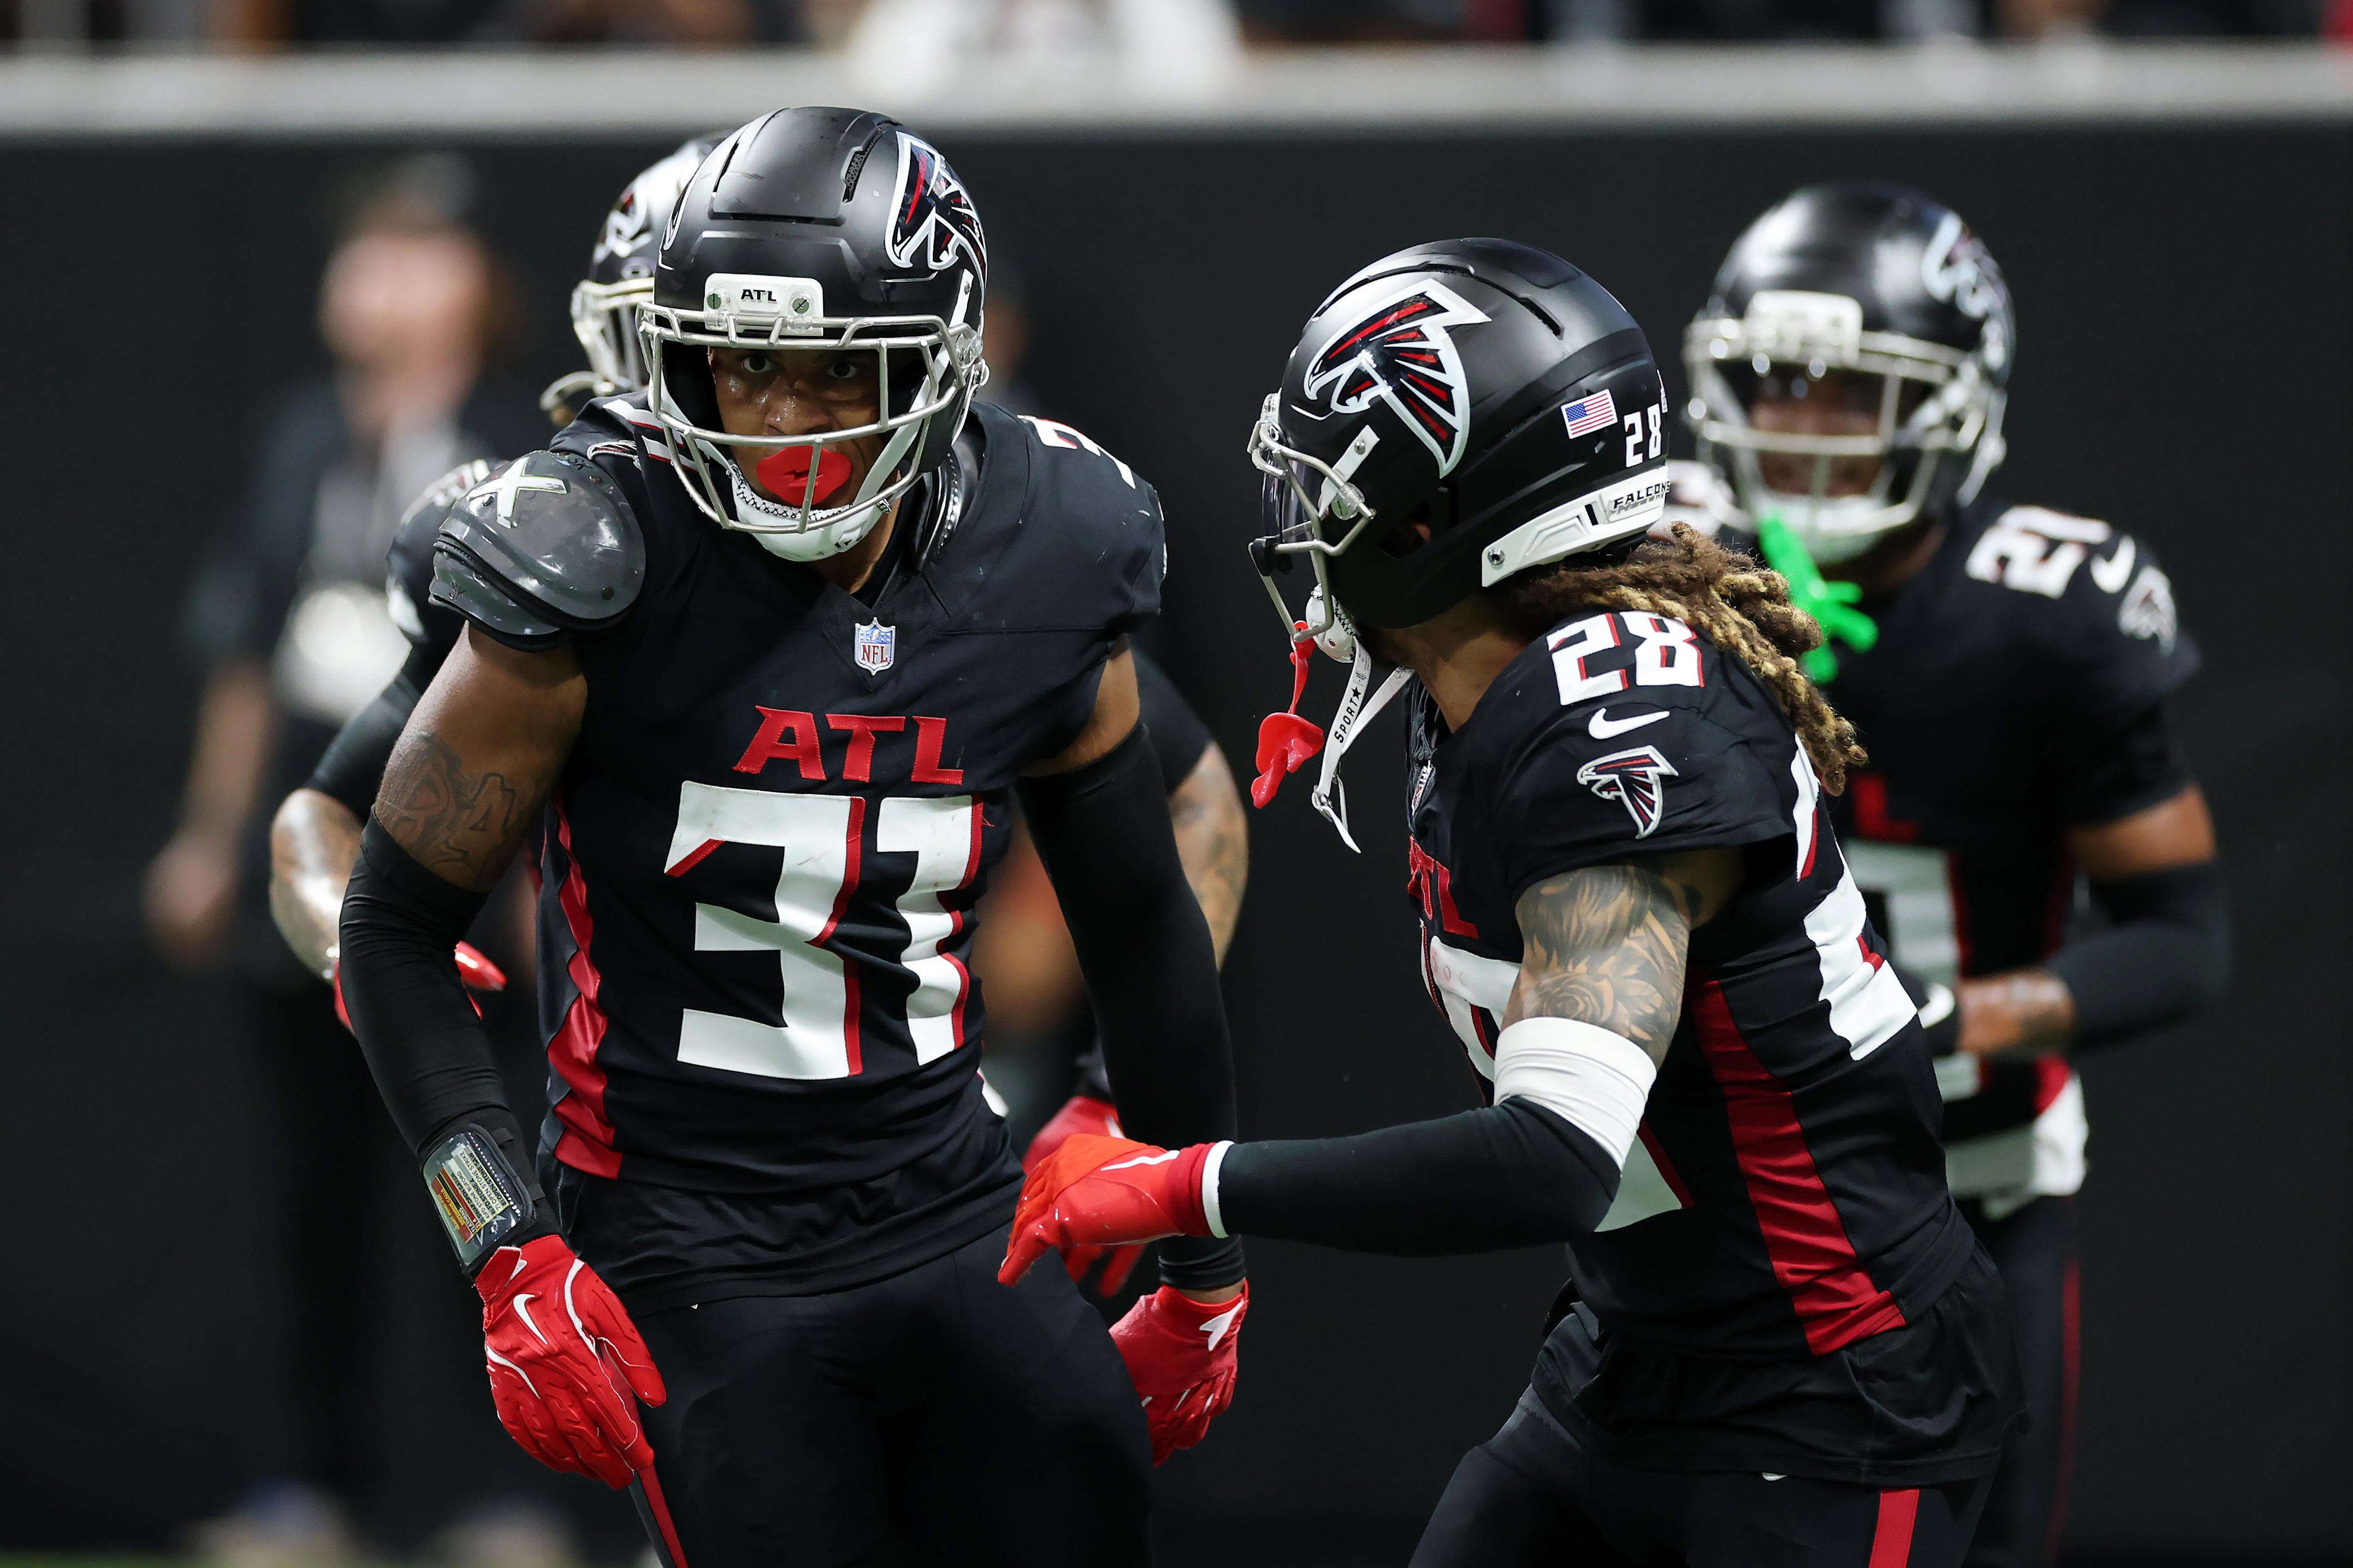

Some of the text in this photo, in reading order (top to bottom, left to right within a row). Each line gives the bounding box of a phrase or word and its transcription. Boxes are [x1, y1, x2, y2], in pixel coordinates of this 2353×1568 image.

[740, 288, 777, 303] ATL
[1624, 403, 1662, 468] 28
[1613, 481, 1671, 510] FALCONS
[860, 643, 889, 664] NFL
[1545, 610, 1705, 706] 28
[1334, 698, 1361, 743] SPORT
[732, 706, 964, 785] ATL
[664, 780, 985, 1080] 31
[460, 1151, 474, 1170] STRIKE
[468, 1152, 479, 1166] SAW
[457, 1171, 471, 1191] BUFORD
[471, 1169, 486, 1188] STONE
[477, 1165, 492, 1184] STONE
[461, 1189, 471, 1203] OPEN
[470, 1191, 482, 1207] STONE
[473, 1182, 486, 1202] STONE
[484, 1188, 497, 1204] OPEN
[489, 1184, 502, 1200] OPEN
